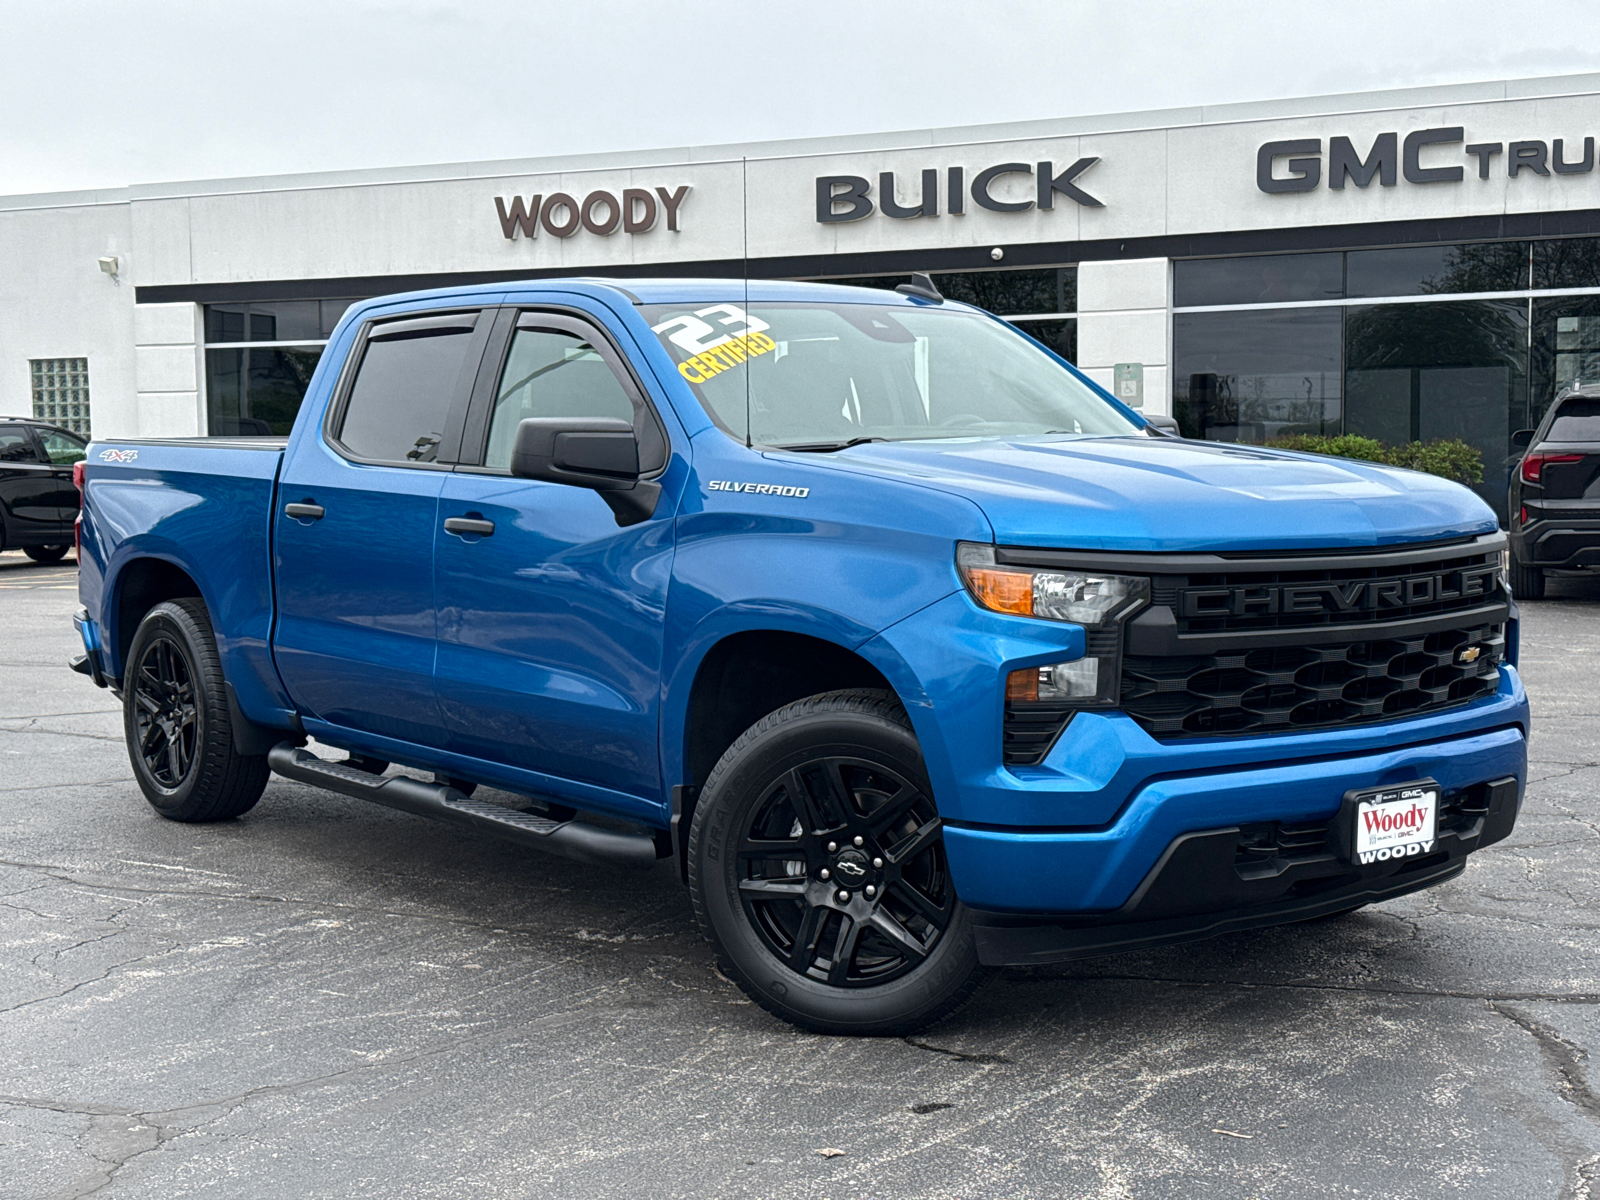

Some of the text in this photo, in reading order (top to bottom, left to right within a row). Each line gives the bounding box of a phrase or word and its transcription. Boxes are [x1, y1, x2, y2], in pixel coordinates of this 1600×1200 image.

[1256, 126, 1600, 194] GMC TRU
[495, 185, 691, 240] WOODY
[816, 157, 1104, 224] BUICK
[650, 303, 770, 356] 23
[677, 331, 776, 383] CERTIFIED
[708, 480, 810, 498] SILVERADO
[1183, 566, 1503, 616] CHEVROLET
[1363, 804, 1428, 834] Woody
[1401, 789, 1422, 799] GMC
[1359, 841, 1434, 864] WOODY
[1398, 830, 1414, 838] GMC
